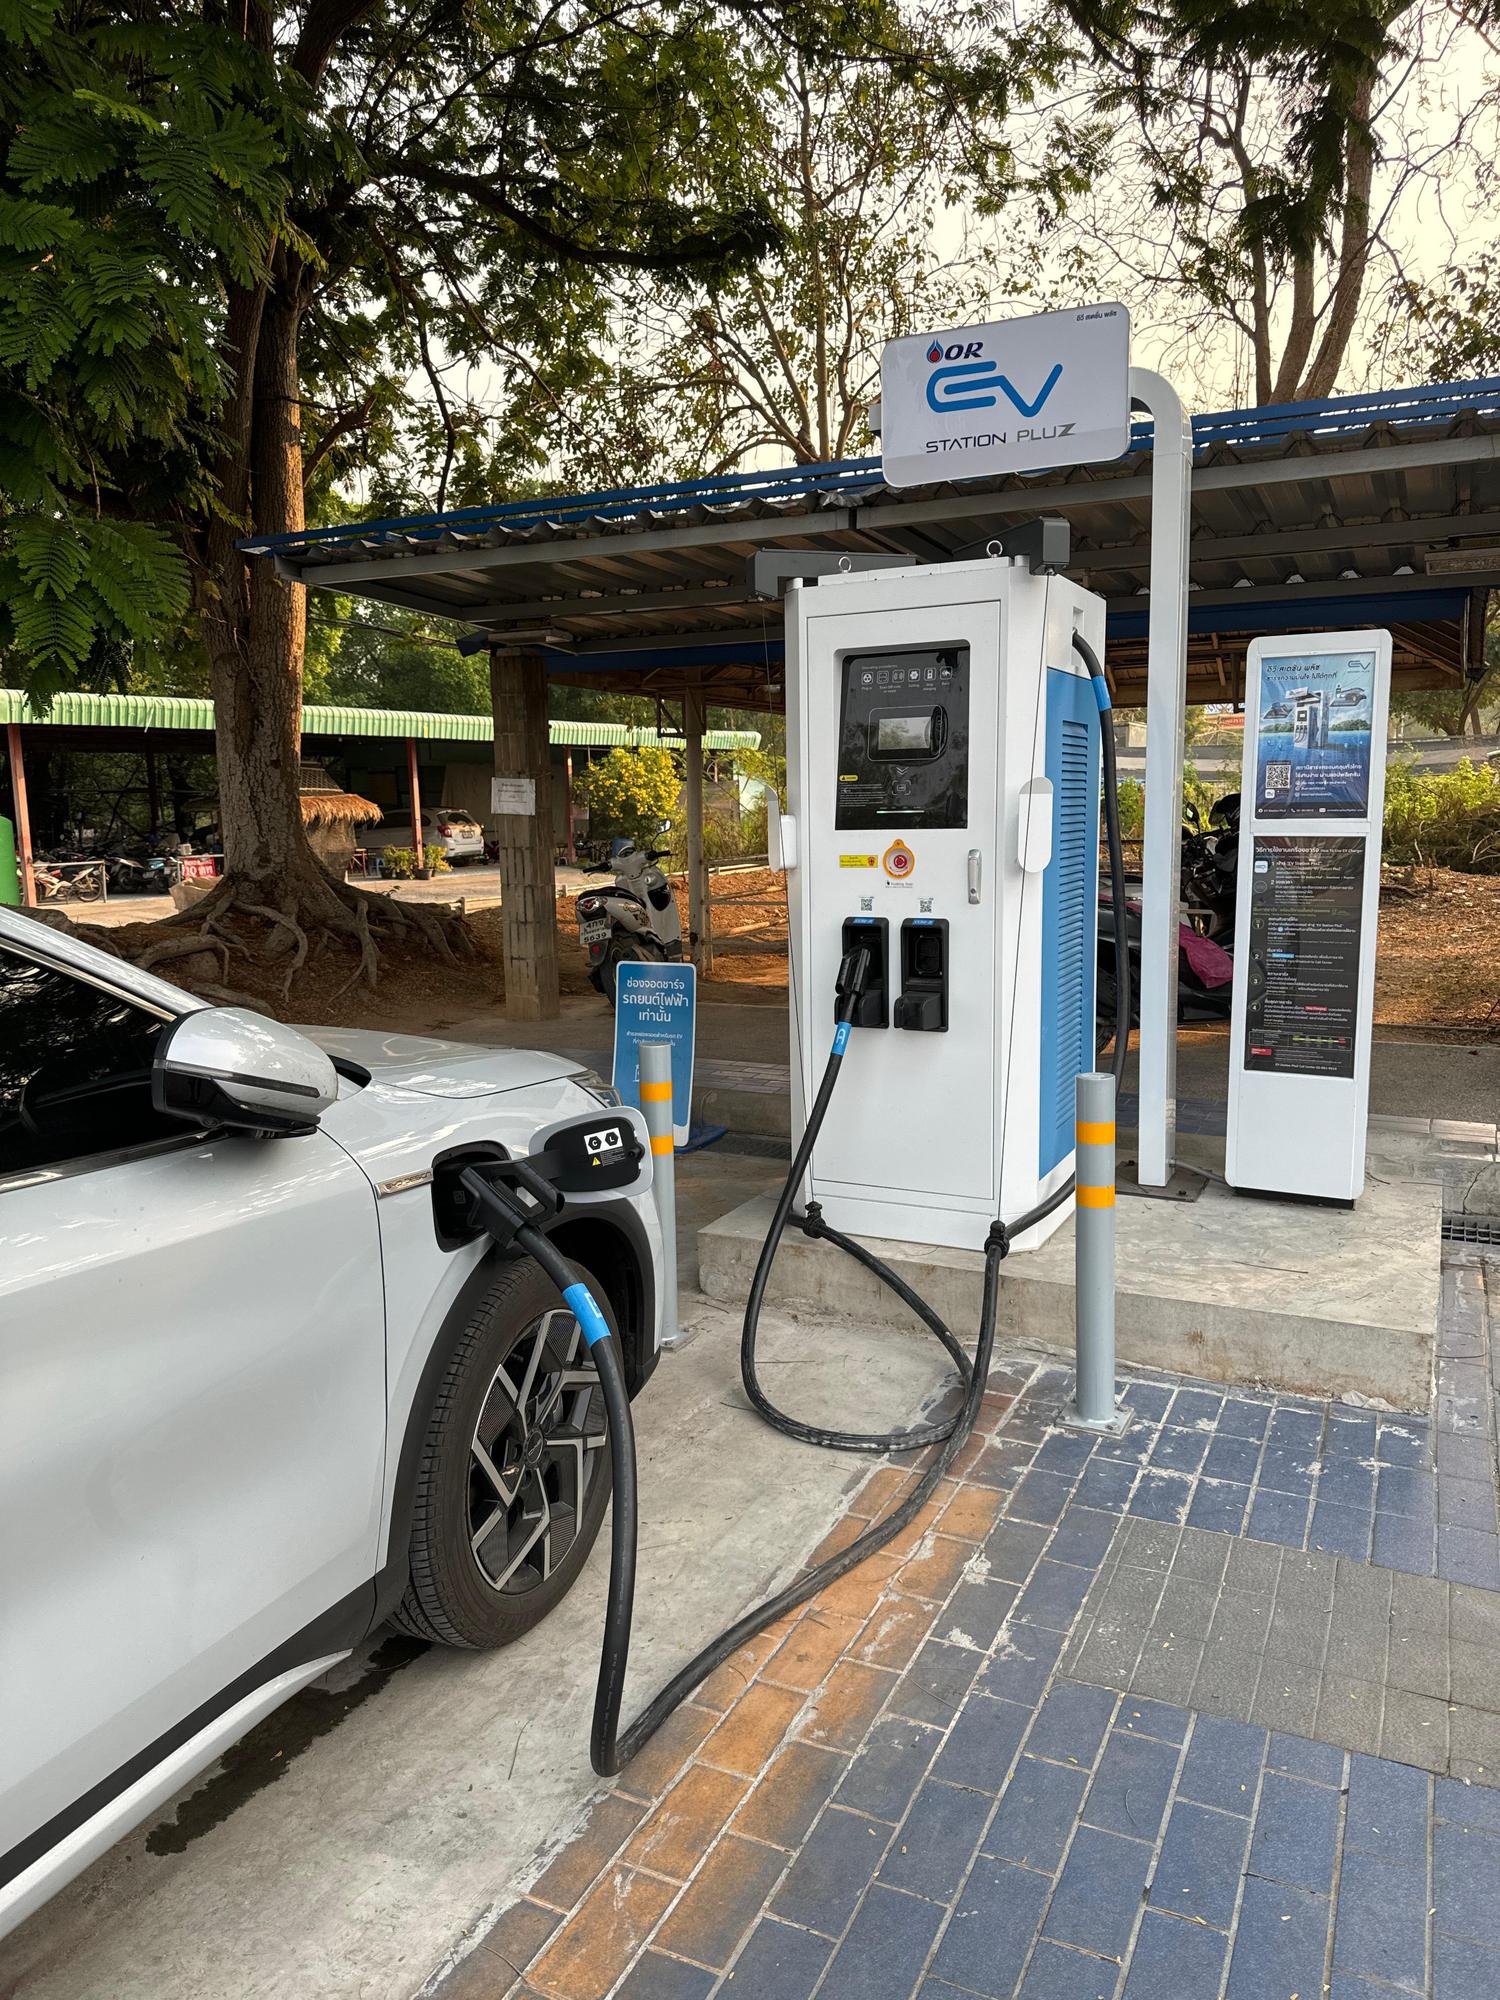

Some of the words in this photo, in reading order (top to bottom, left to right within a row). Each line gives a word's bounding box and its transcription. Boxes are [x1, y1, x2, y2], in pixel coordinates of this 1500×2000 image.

[944, 341, 984, 361] OR
[926, 360, 1063, 417] EV
[926, 432, 1007, 454] STATION
[583, 932, 607, 943] 5639
[626, 977, 685, 990] ช่องจอดชาร์จ
[622, 992, 689, 1007] รถยนต์ไฟฟ้า
[638, 1005, 672, 1022] เท่านั้น
[835, 1028, 847, 1045] A
[591, 1139, 598, 1147] C
